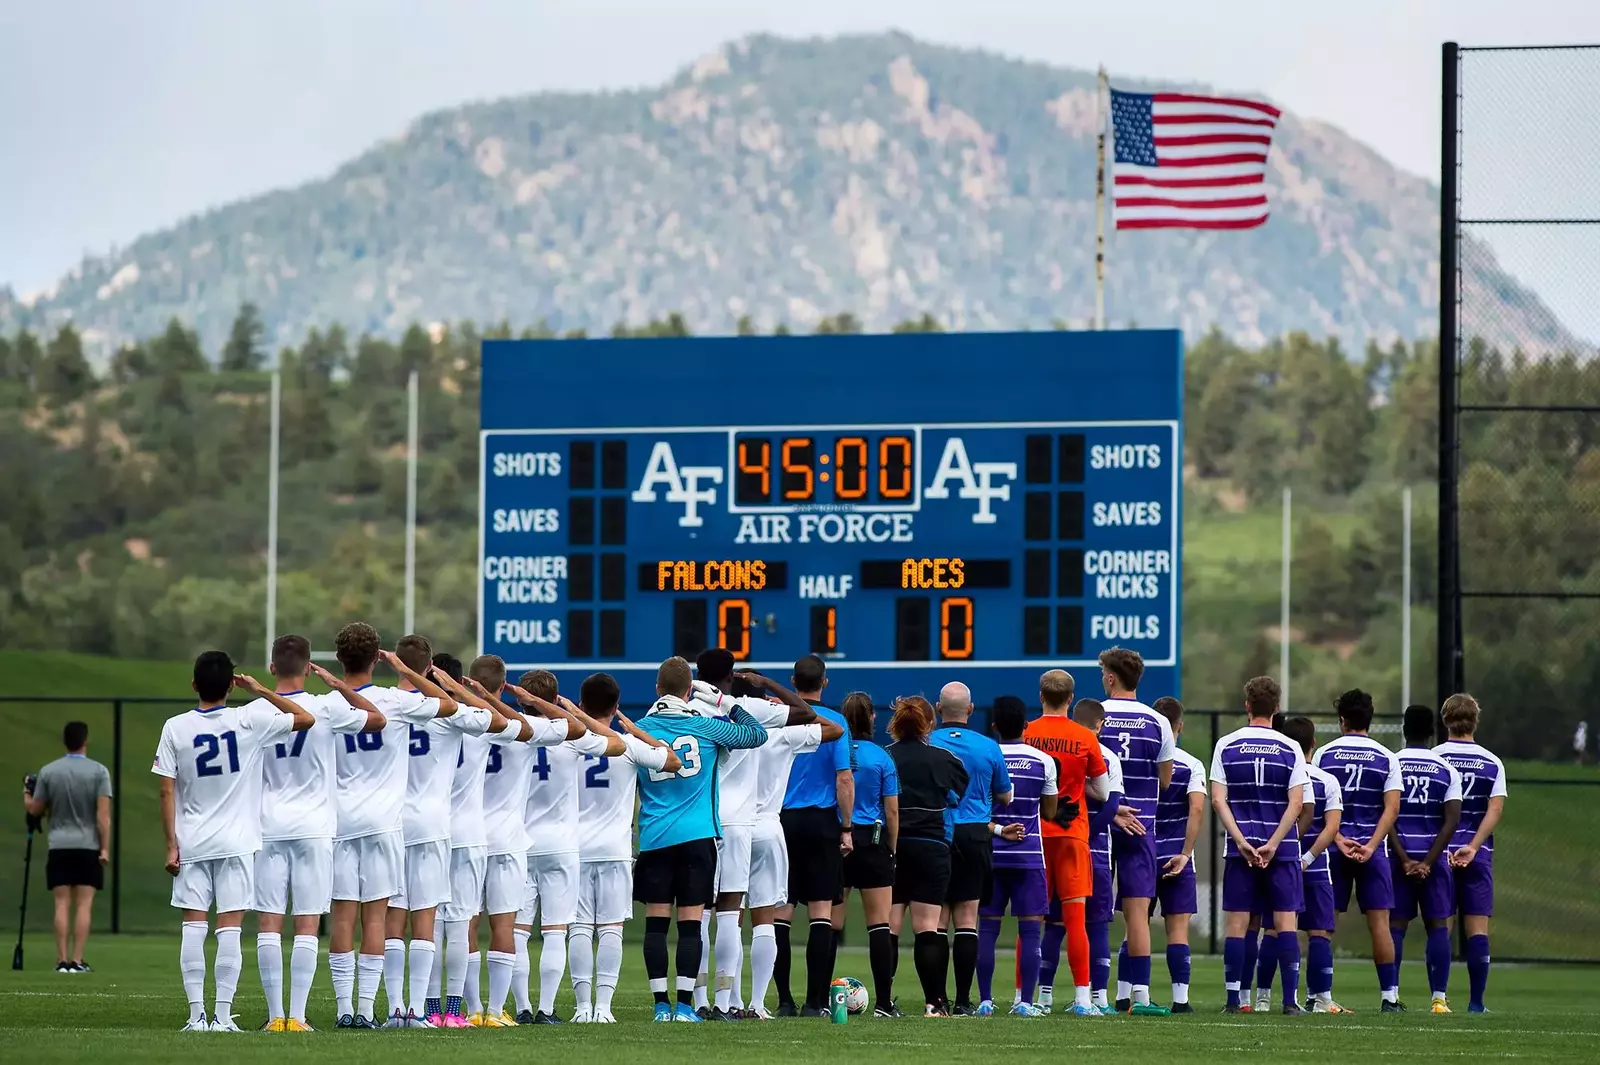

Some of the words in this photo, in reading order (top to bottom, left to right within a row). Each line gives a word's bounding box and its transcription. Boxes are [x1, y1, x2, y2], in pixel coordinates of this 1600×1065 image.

[493, 452, 562, 477] SHOTS
[738, 437, 912, 499] 45:00
[1090, 444, 1161, 469] SHOTS
[632, 441, 724, 527] AF
[924, 437, 1017, 524] AF
[493, 508, 560, 533] SAVES
[734, 514, 793, 544] AIR
[797, 513, 914, 543] FORCE
[1092, 501, 1162, 527] SAVES
[484, 556, 568, 580] CORNER
[657, 560, 767, 591] FALCONS
[901, 557, 965, 589] ACES
[1084, 550, 1171, 574] CORNER
[497, 580, 558, 604] KICKS
[798, 574, 853, 600] HALF
[1096, 575, 1159, 599] KICKS
[494, 619, 562, 644] FOULS
[717, 599, 750, 660] 0
[827, 607, 836, 649] 1
[940, 597, 973, 658] 0
[1090, 614, 1161, 640] FOULS
[1104, 715, 1147, 729] Evansville
[193, 730, 240, 778] 21
[1117, 732, 1131, 761] 3
[1239, 742, 1281, 756] Evansville
[1334, 748, 1376, 762] Evansville
[584, 753, 610, 788] 2
[1254, 757, 1265, 787] 11
[1345, 763, 1363, 792] 21
[1407, 775, 1430, 804] 23
